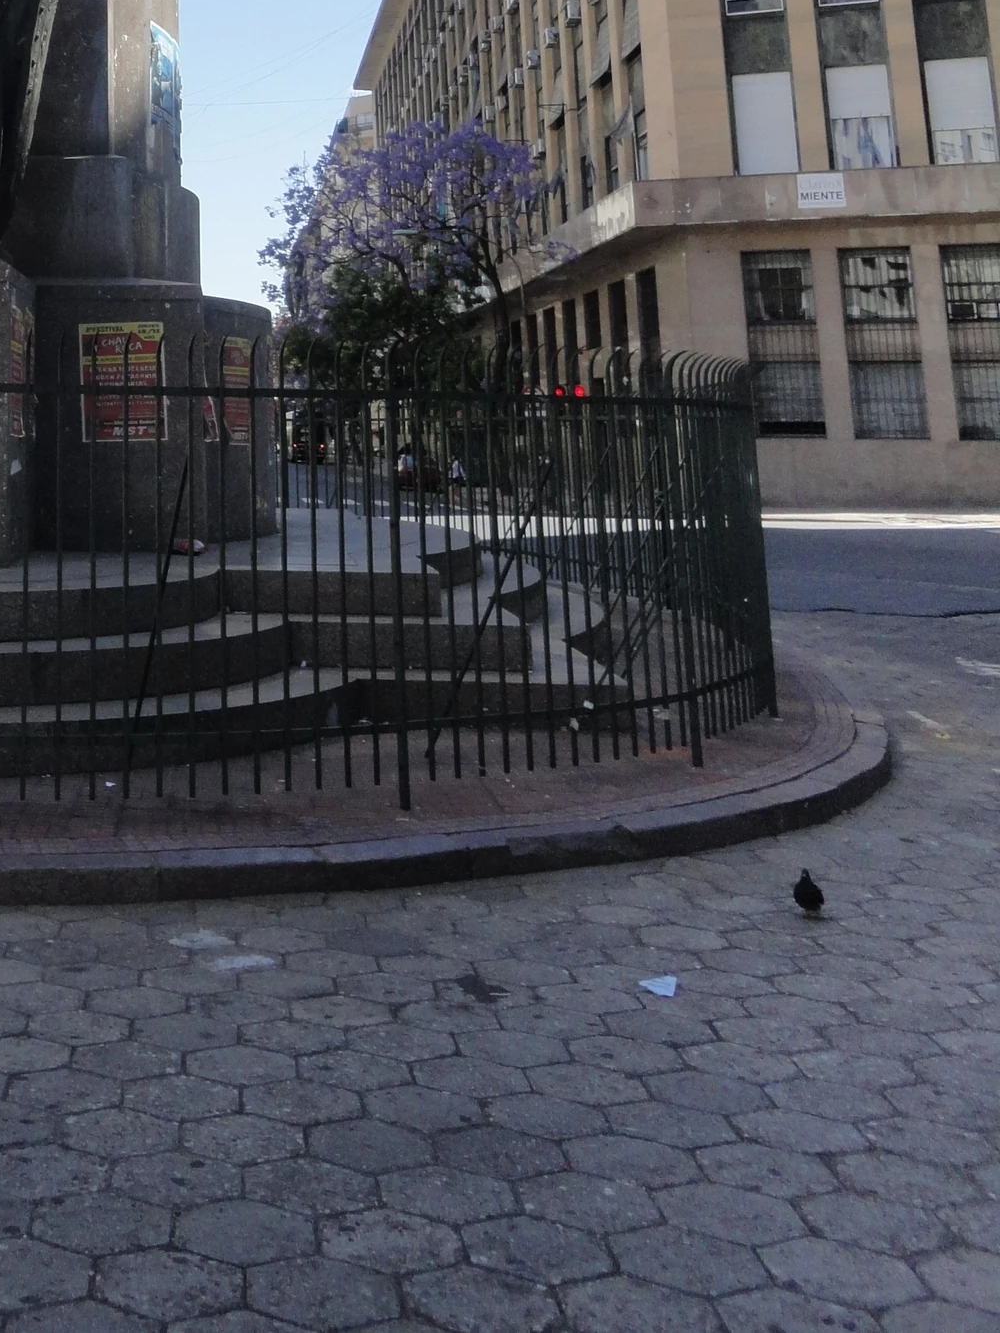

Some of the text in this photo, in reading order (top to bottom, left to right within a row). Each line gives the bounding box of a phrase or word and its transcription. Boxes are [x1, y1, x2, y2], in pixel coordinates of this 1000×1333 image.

[799, 191, 843, 201] MIENTE
[115, 342, 143, 354] RCA
[112, 426, 148, 436] MST
